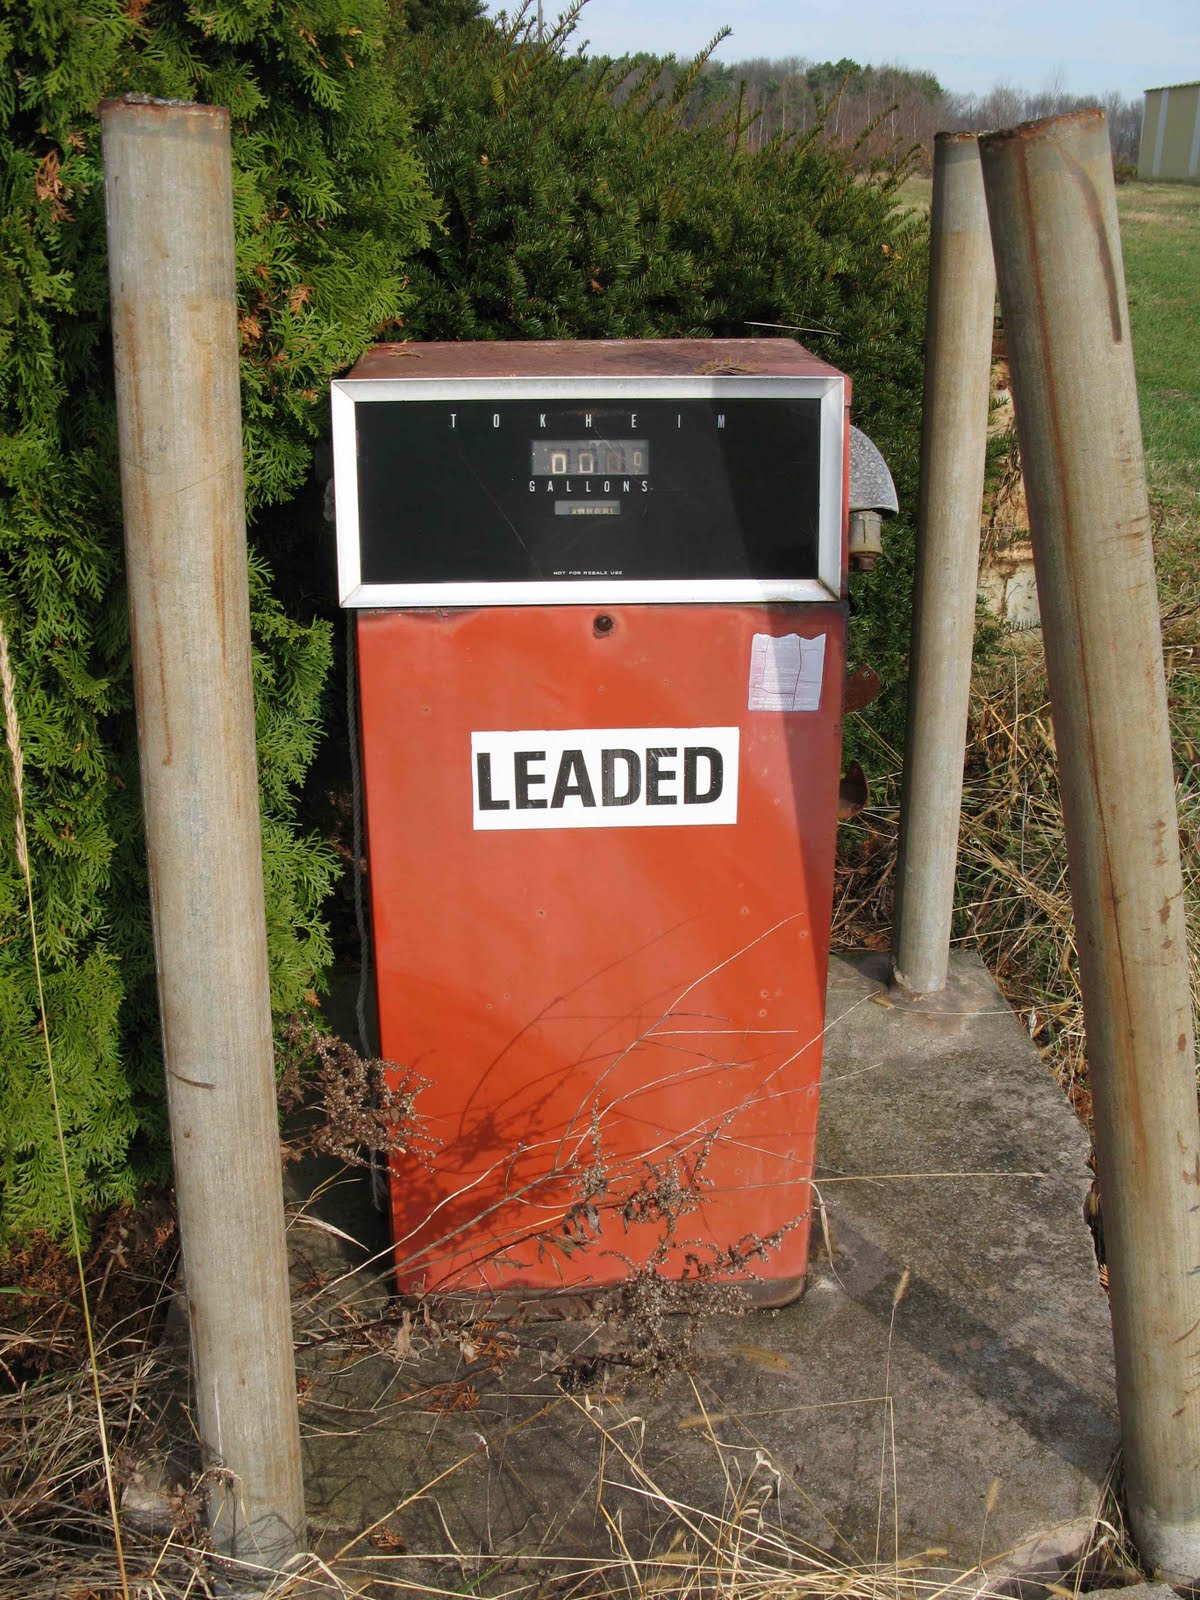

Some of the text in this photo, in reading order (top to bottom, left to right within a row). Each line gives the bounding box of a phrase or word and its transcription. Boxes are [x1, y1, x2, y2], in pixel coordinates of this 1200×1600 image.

[450, 414, 726, 428] TOKHEIM
[529, 480, 648, 493] GALLONS
[477, 747, 723, 810] LEADED
